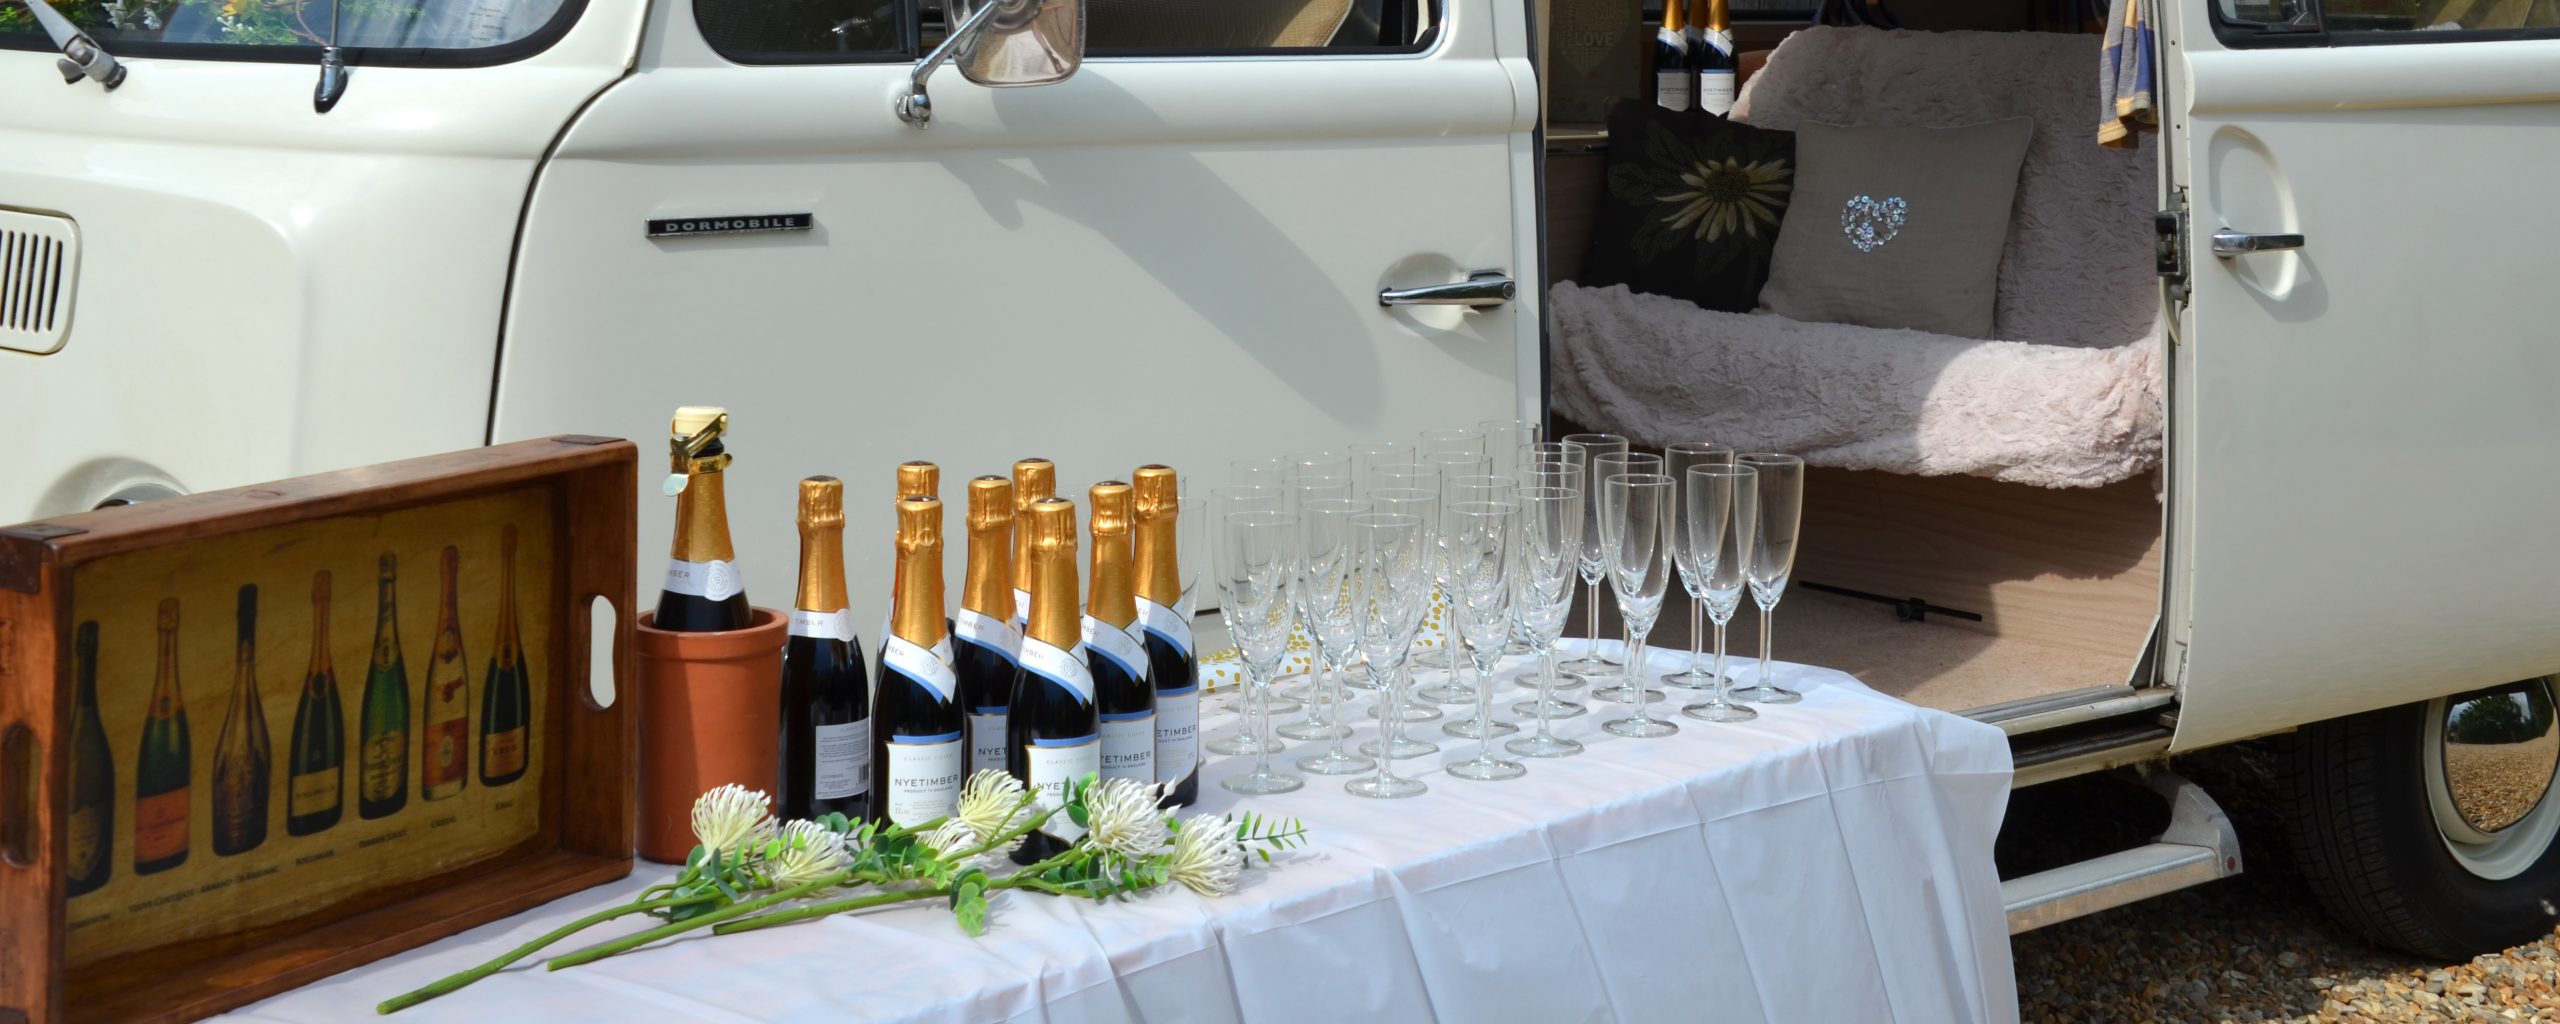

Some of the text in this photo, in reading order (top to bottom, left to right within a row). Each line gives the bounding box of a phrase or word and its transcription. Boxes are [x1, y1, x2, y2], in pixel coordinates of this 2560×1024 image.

[1575, 31, 1615, 46] LOVE
[665, 217, 796, 232] DORMOBILE
[894, 773, 959, 787] NYETIMBER
